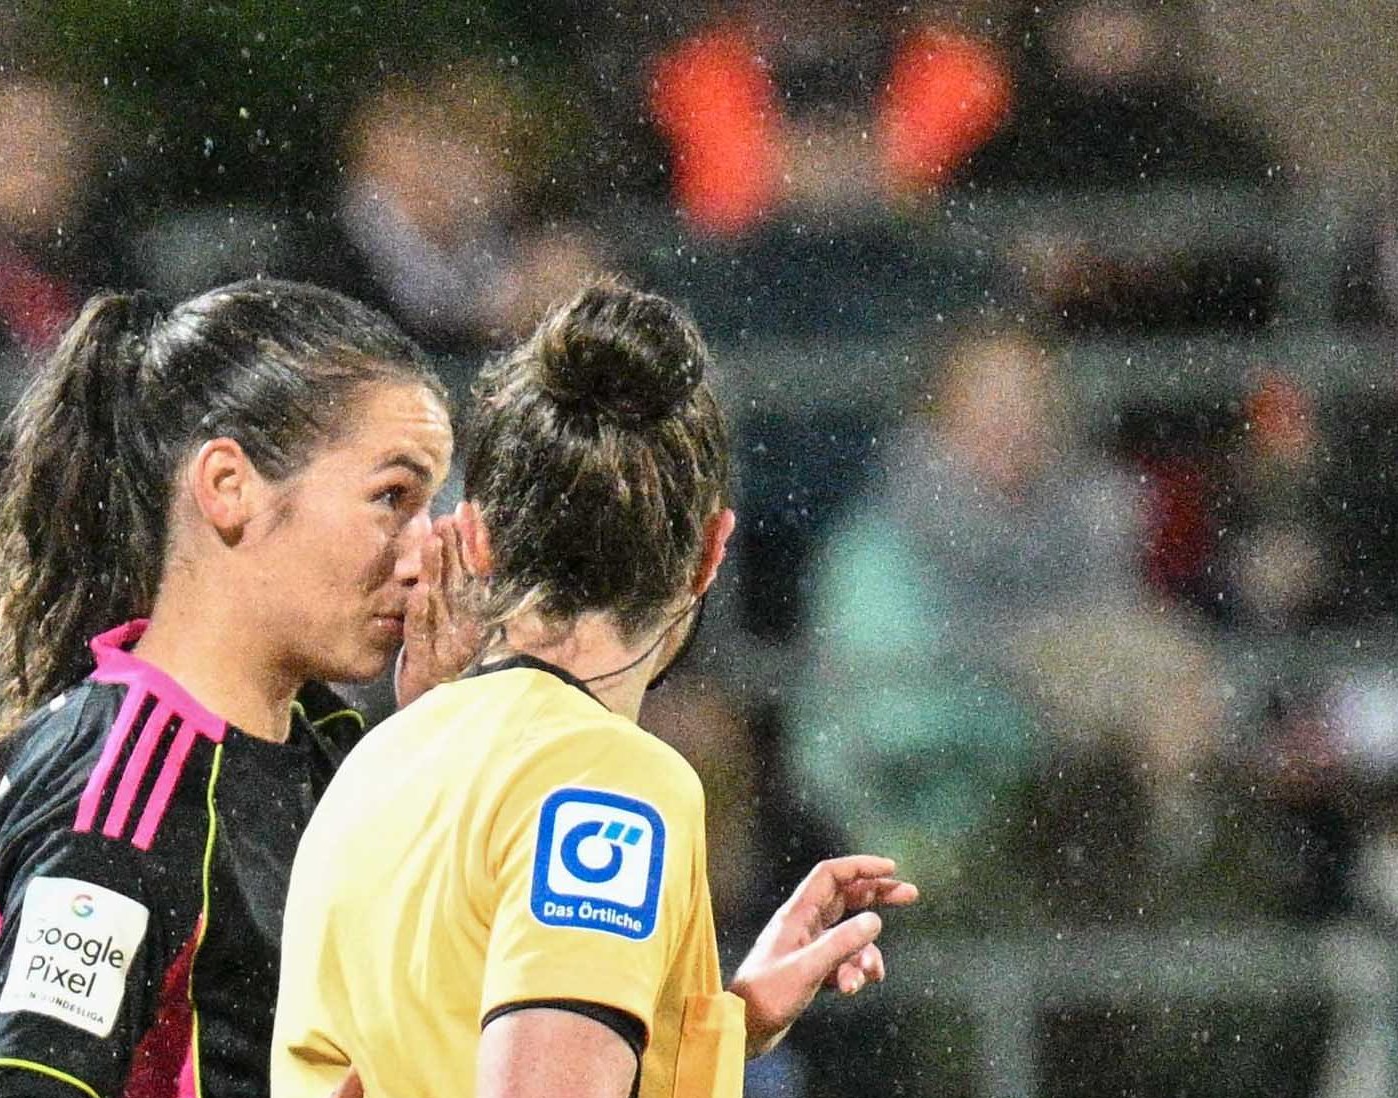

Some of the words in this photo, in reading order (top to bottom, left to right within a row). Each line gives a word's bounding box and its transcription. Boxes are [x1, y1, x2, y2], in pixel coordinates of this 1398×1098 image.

[543, 901, 575, 918] Das
[578, 900, 643, 932] Örtliche
[26, 955, 97, 998] Pixel
